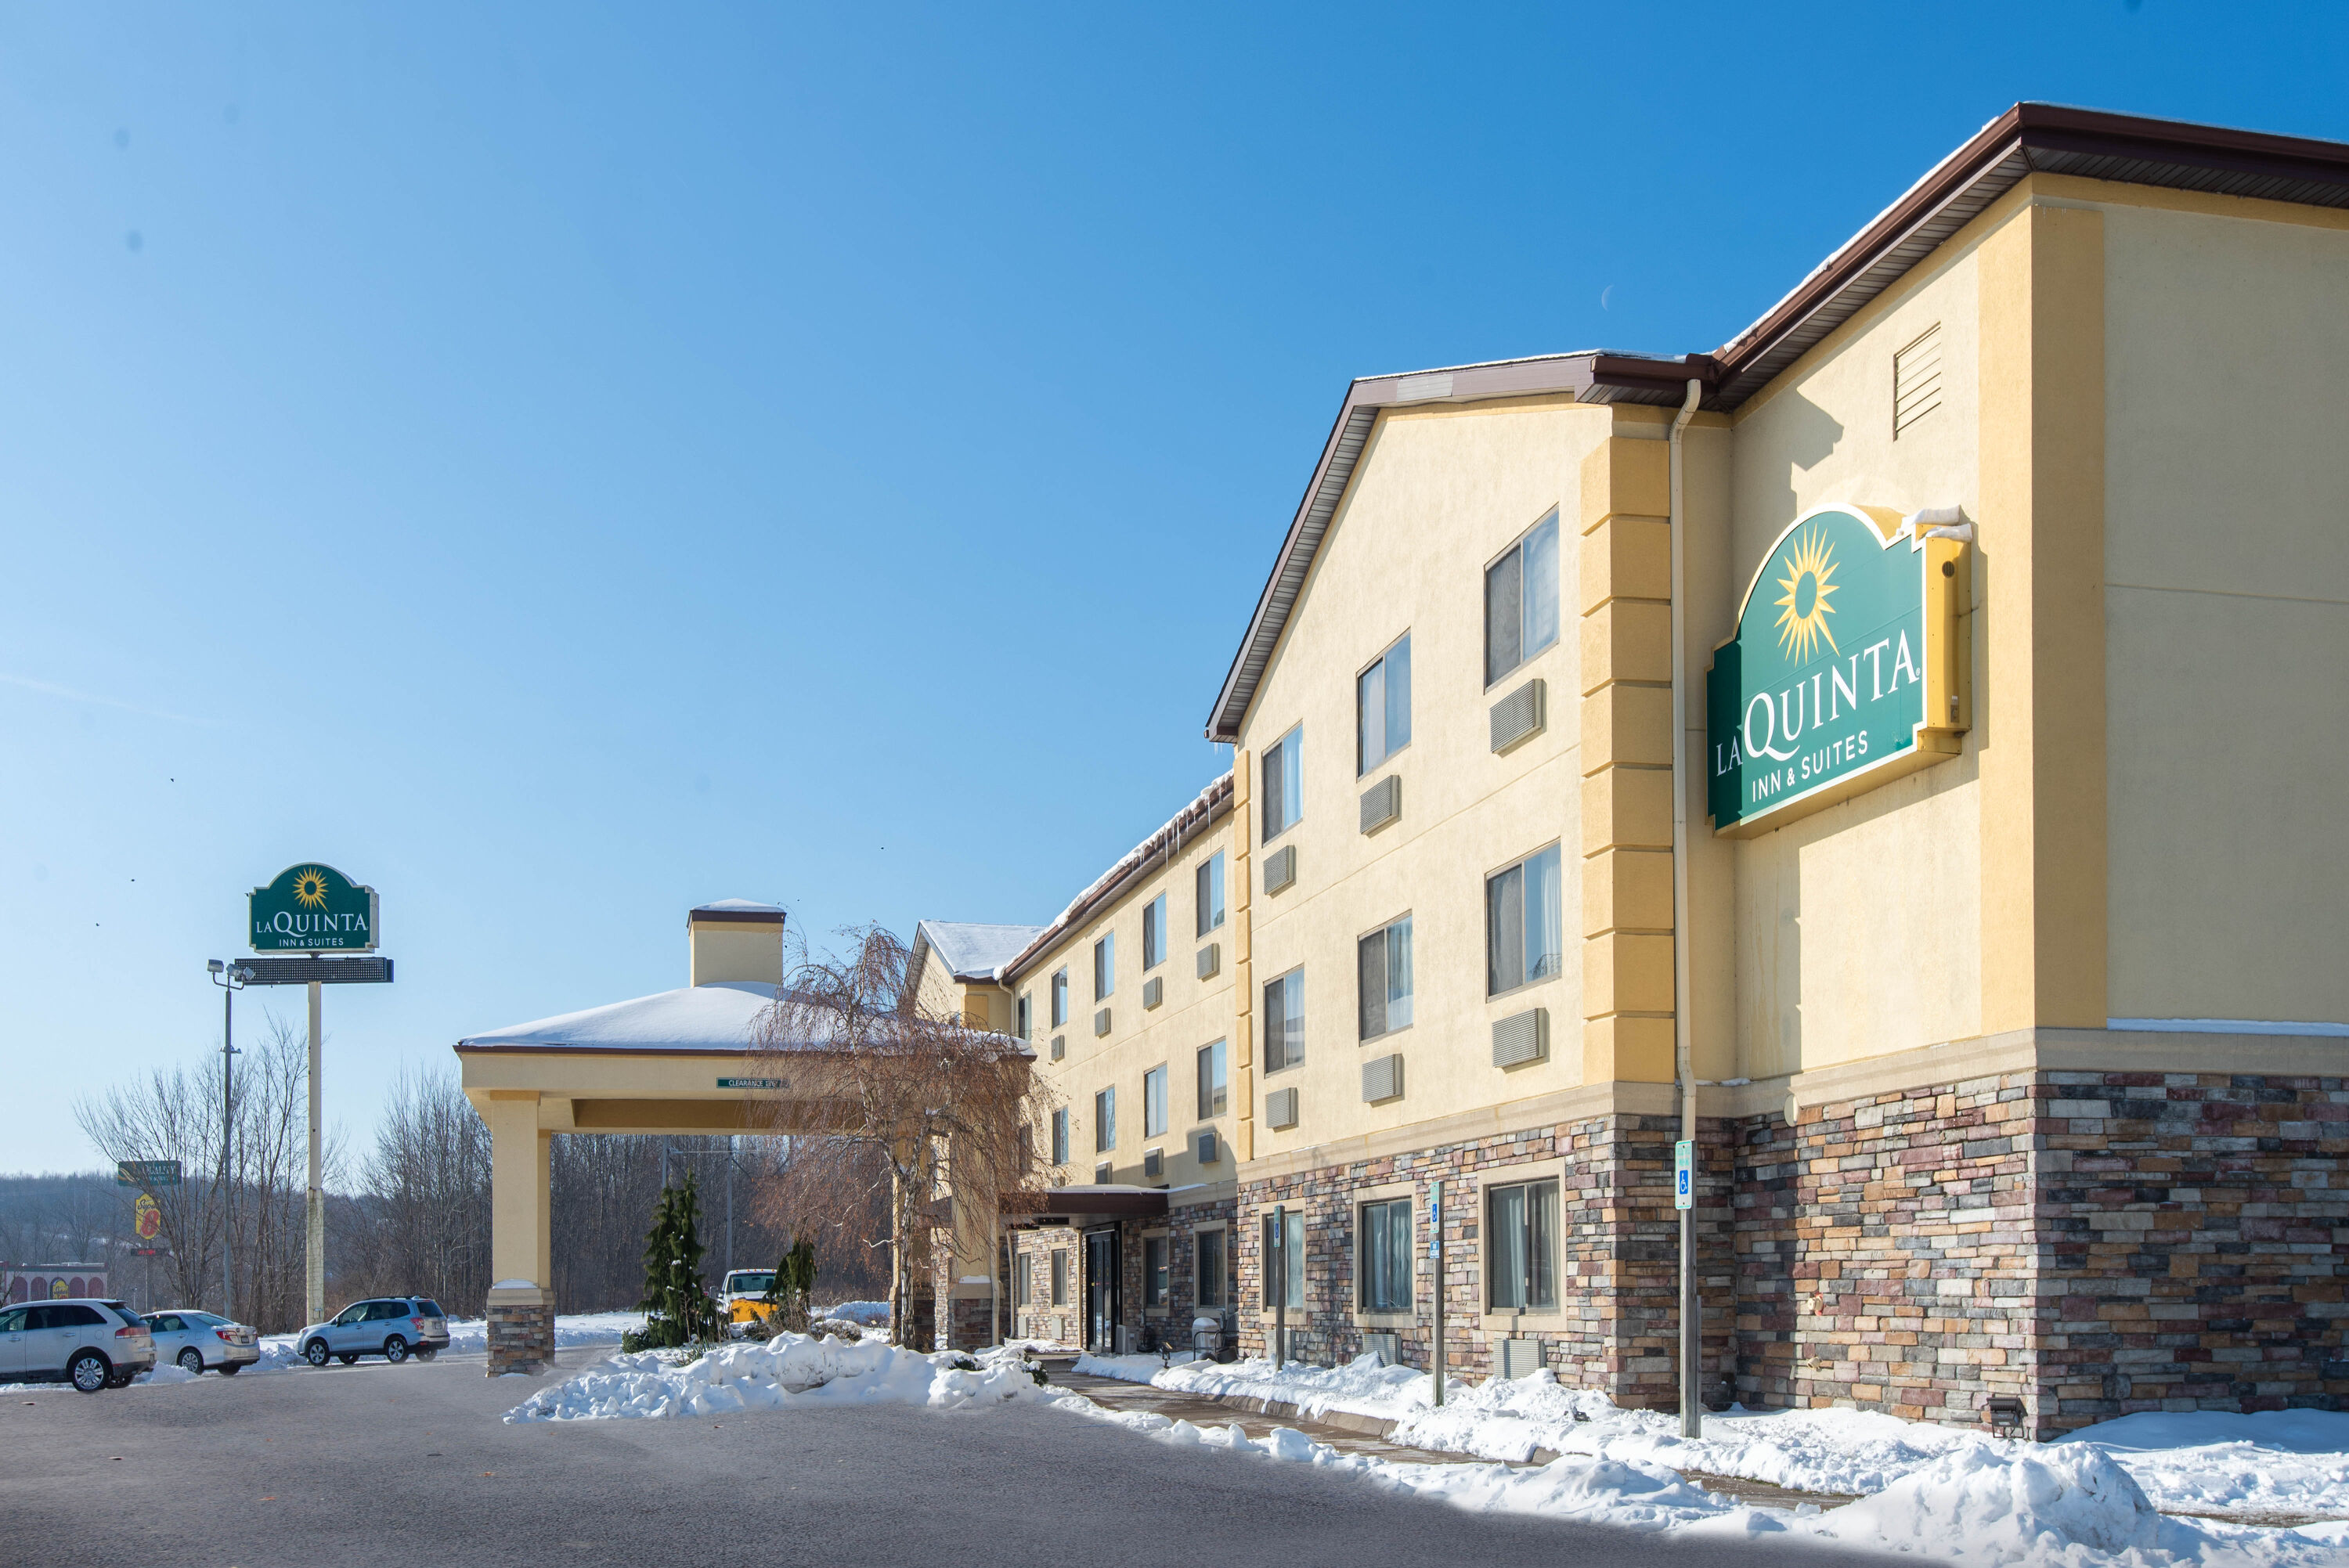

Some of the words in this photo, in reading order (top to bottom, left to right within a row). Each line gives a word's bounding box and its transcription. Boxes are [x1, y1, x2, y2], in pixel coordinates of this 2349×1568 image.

[1716, 735, 1743, 777] LA
[1744, 629, 1920, 762] QUINTA
[1752, 770, 1781, 802] INN
[1787, 767, 1795, 787] &
[1802, 730, 1868, 780] SUITES
[256, 921, 272, 933] LA
[274, 911, 367, 938] QUINTA
[308, 938, 344, 946] SUITES
[141, 1209, 160, 1237] 8
